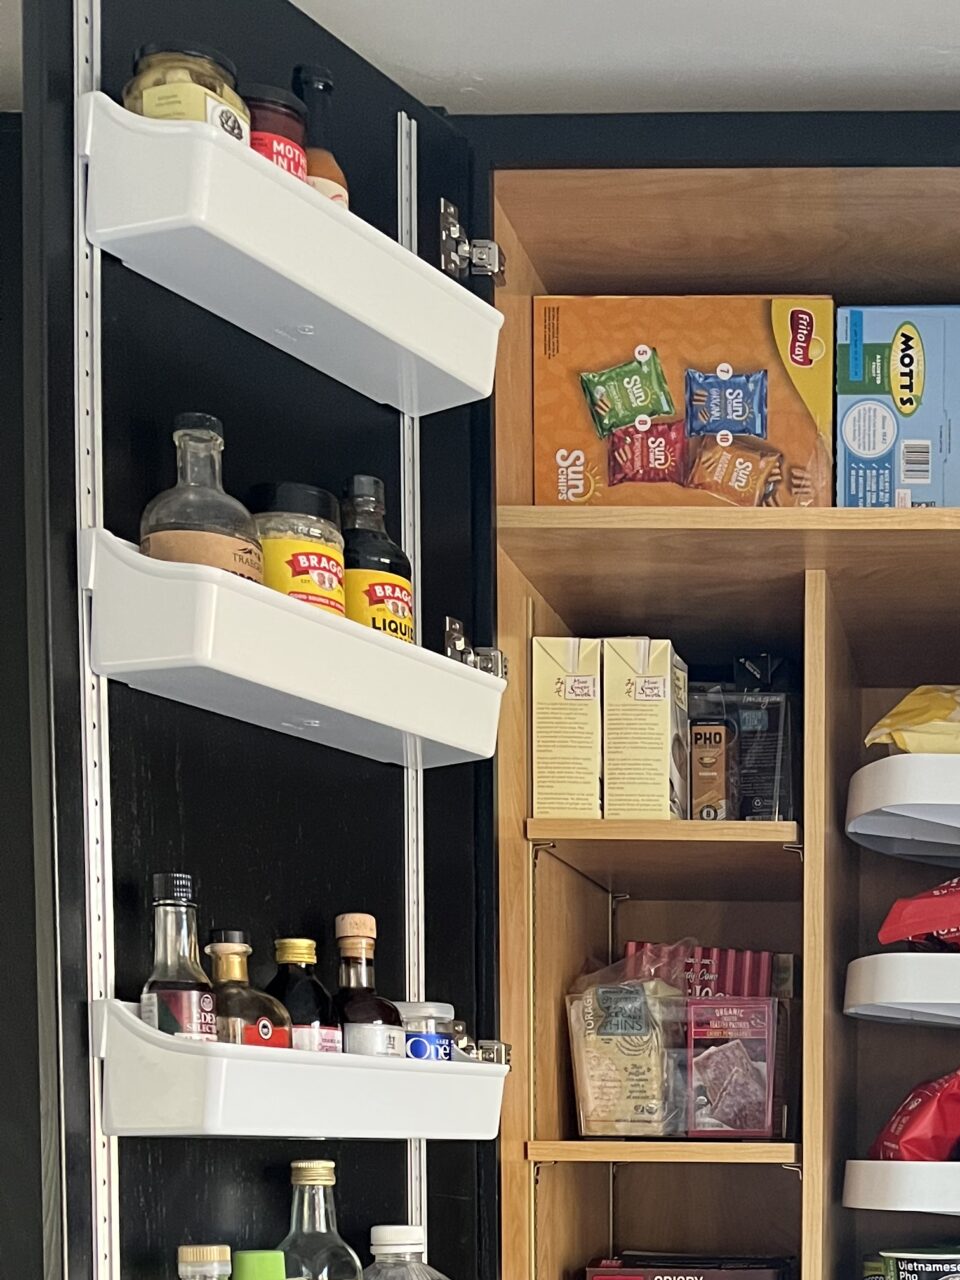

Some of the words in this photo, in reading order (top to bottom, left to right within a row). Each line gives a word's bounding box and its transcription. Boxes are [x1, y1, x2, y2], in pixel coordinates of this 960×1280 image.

[720, 367, 730, 375] 7
[720, 432, 730, 444] 10
[556, 449, 585, 501] Sun
[558, 467, 567, 500] CHIPS
[694, 732, 722, 745] PHO
[406, 1037, 449, 1060] One
